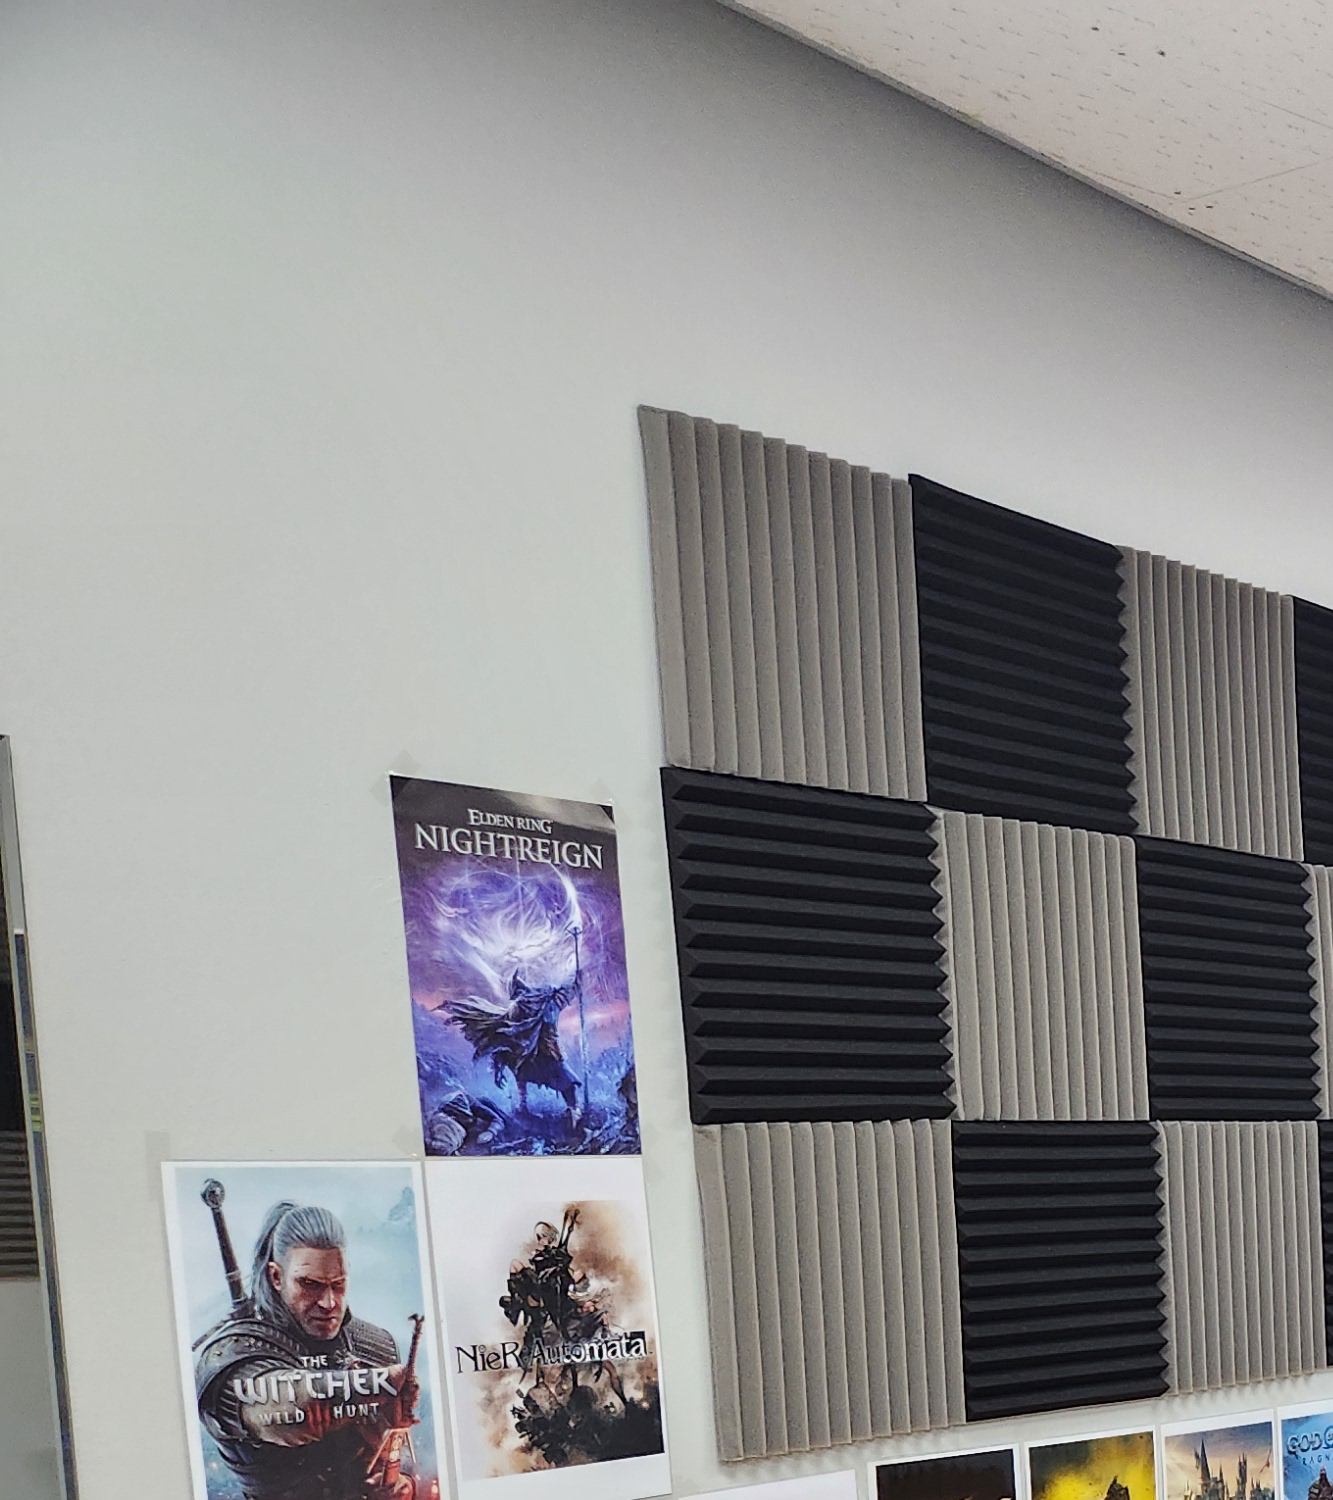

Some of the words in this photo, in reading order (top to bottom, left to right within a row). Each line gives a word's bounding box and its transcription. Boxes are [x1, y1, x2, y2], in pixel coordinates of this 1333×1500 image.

[467, 808, 514, 829] ELDEN
[517, 815, 552, 834] RING
[414, 822, 603, 869] NIGHTREIGN
[300, 1354, 329, 1369] THE
[233, 1367, 398, 1405] WITCHER
[259, 1408, 305, 1426] WILD
[333, 1402, 380, 1419] HUNT
[1287, 1431, 1323, 1459] GOD
